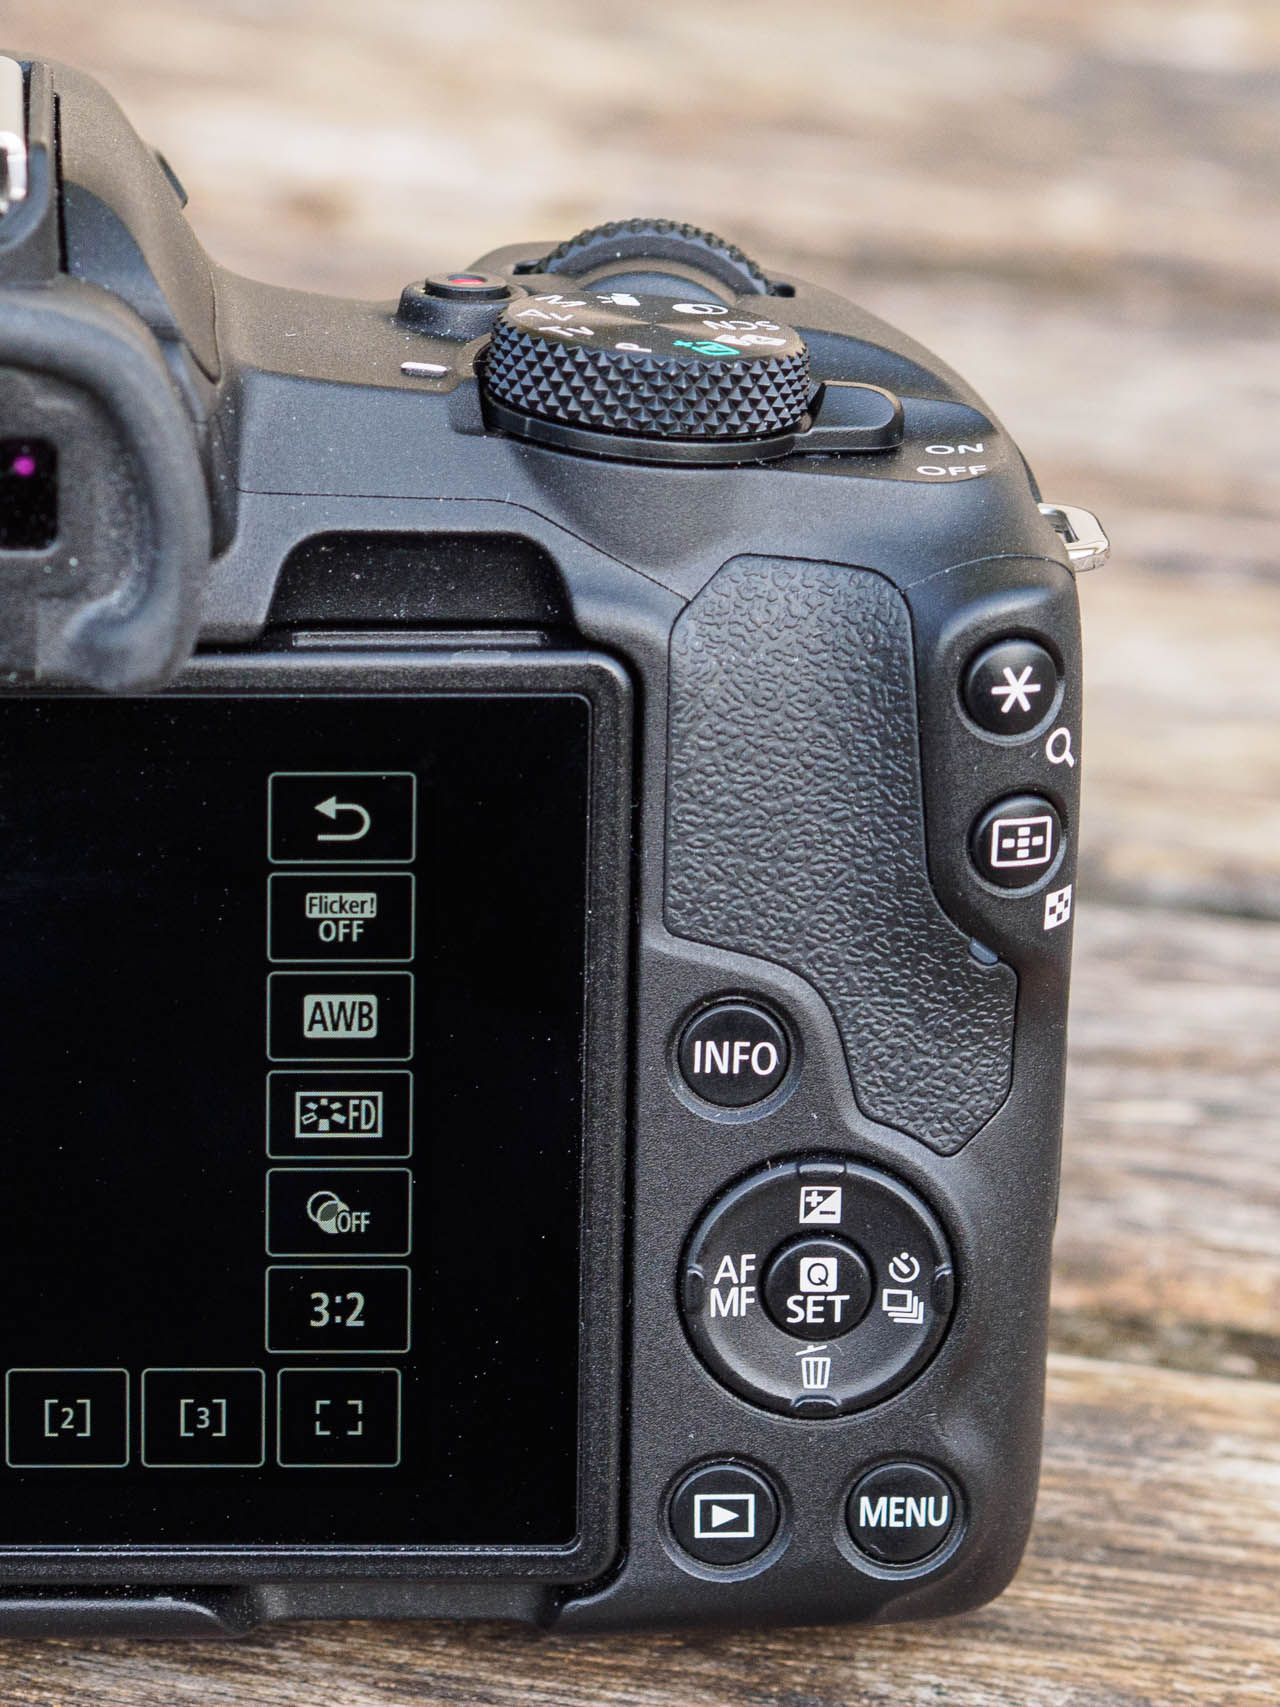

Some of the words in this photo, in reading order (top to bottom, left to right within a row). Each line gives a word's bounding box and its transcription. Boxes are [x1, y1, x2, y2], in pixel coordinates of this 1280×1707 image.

[925, 443, 984, 455] ON
[916, 465, 988, 476] OFF
[319, 920, 364, 942] OFF
[307, 1001, 374, 1032] AWB
[693, 1041, 777, 1074] INFO
[348, 1099, 376, 1130] FD
[337, 1212, 370, 1233] OFF
[713, 1254, 756, 1284] AF
[310, 1292, 365, 1327] 3:2
[710, 1287, 755, 1317] MF
[786, 1295, 850, 1323] SET
[859, 1496, 949, 1529] MENU
